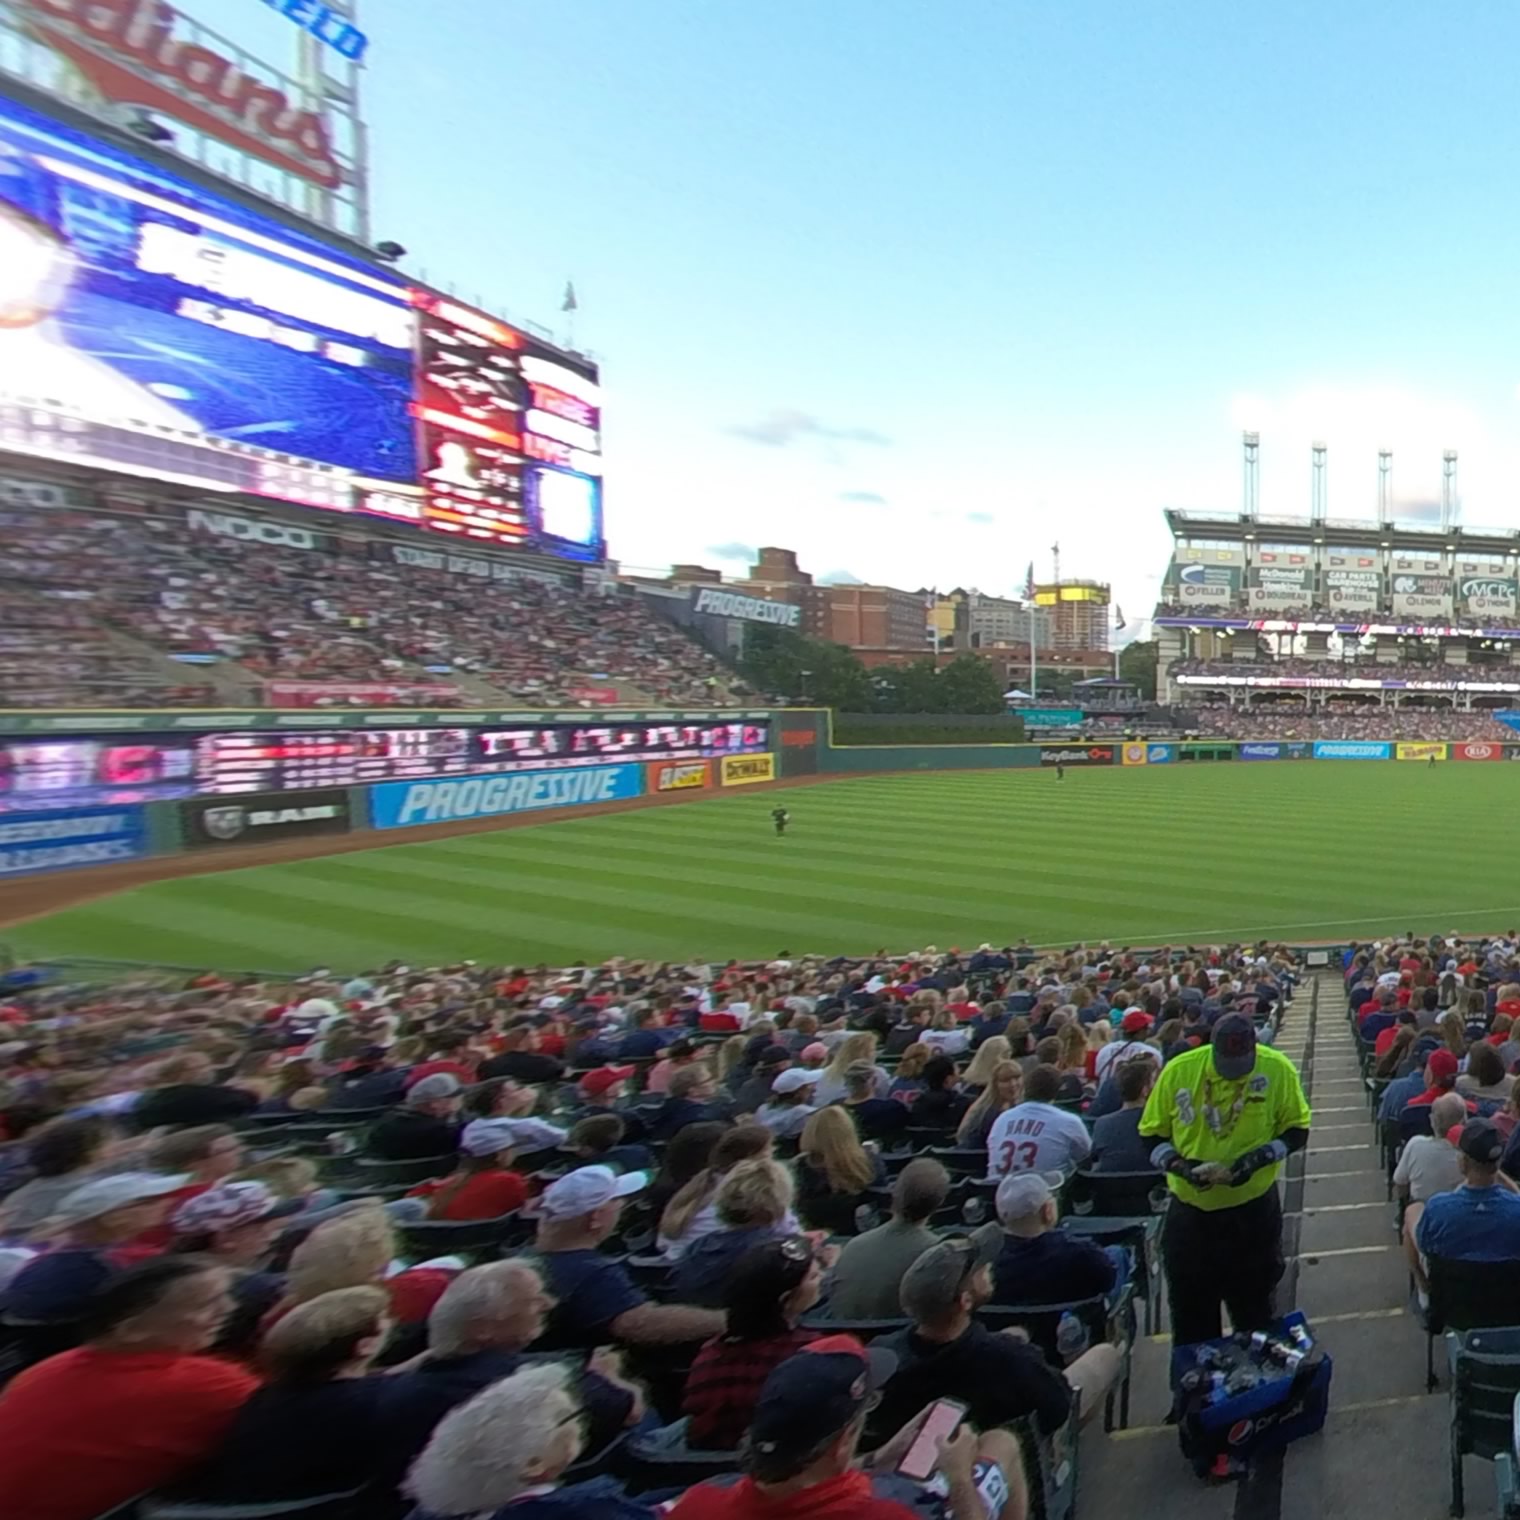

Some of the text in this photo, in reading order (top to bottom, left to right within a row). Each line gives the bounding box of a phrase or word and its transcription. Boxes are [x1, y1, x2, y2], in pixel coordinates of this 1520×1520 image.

[693, 588, 801, 627] PROGRESSIVE
[1041, 750, 1088, 762] KeyBank
[1469, 746, 1488, 756] KIA
[397, 767, 624, 824] PROGRESSIVE
[1005, 1119, 1046, 1137] HAND
[995, 1140, 1039, 1174] 33
